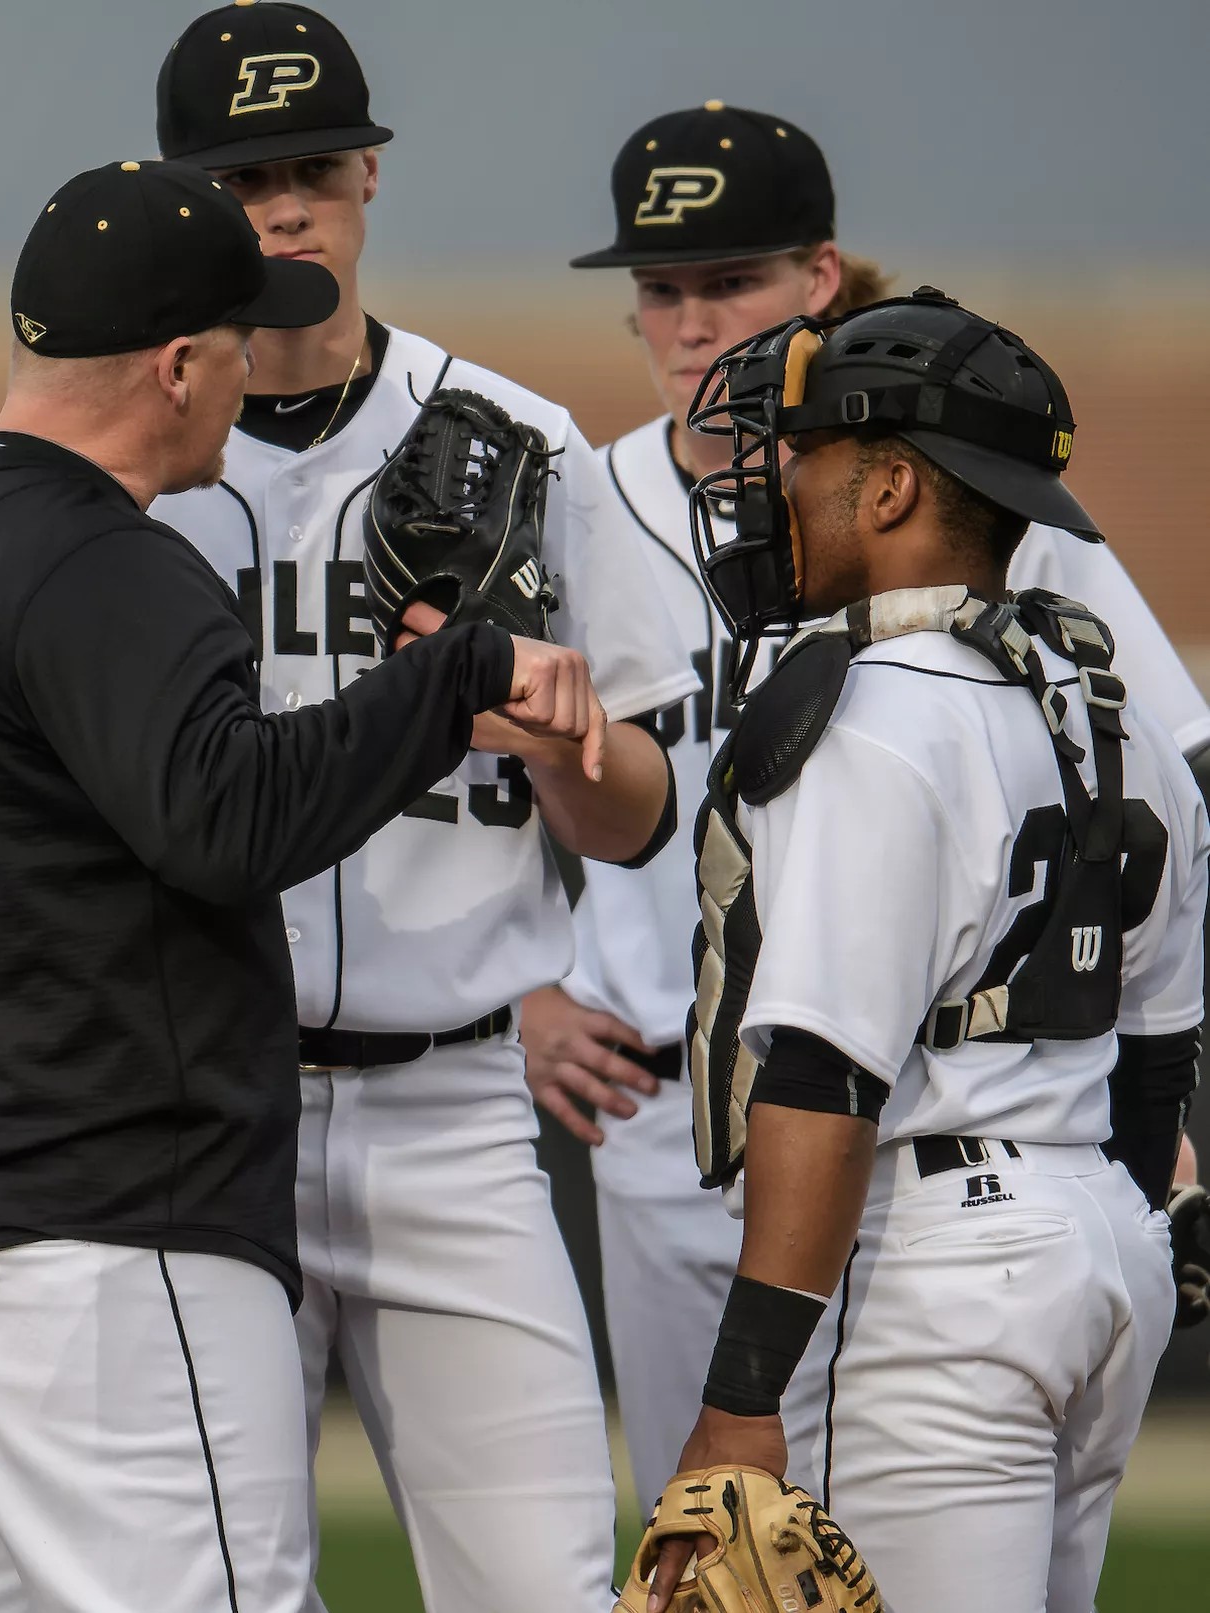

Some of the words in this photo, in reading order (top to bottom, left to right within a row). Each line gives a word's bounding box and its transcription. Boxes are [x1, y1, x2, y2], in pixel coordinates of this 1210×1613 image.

[229, 53, 320, 116] P
[634, 167, 725, 225] P
[1071, 925, 1102, 972] W
[961, 1193, 1016, 1208] RUSSELL
